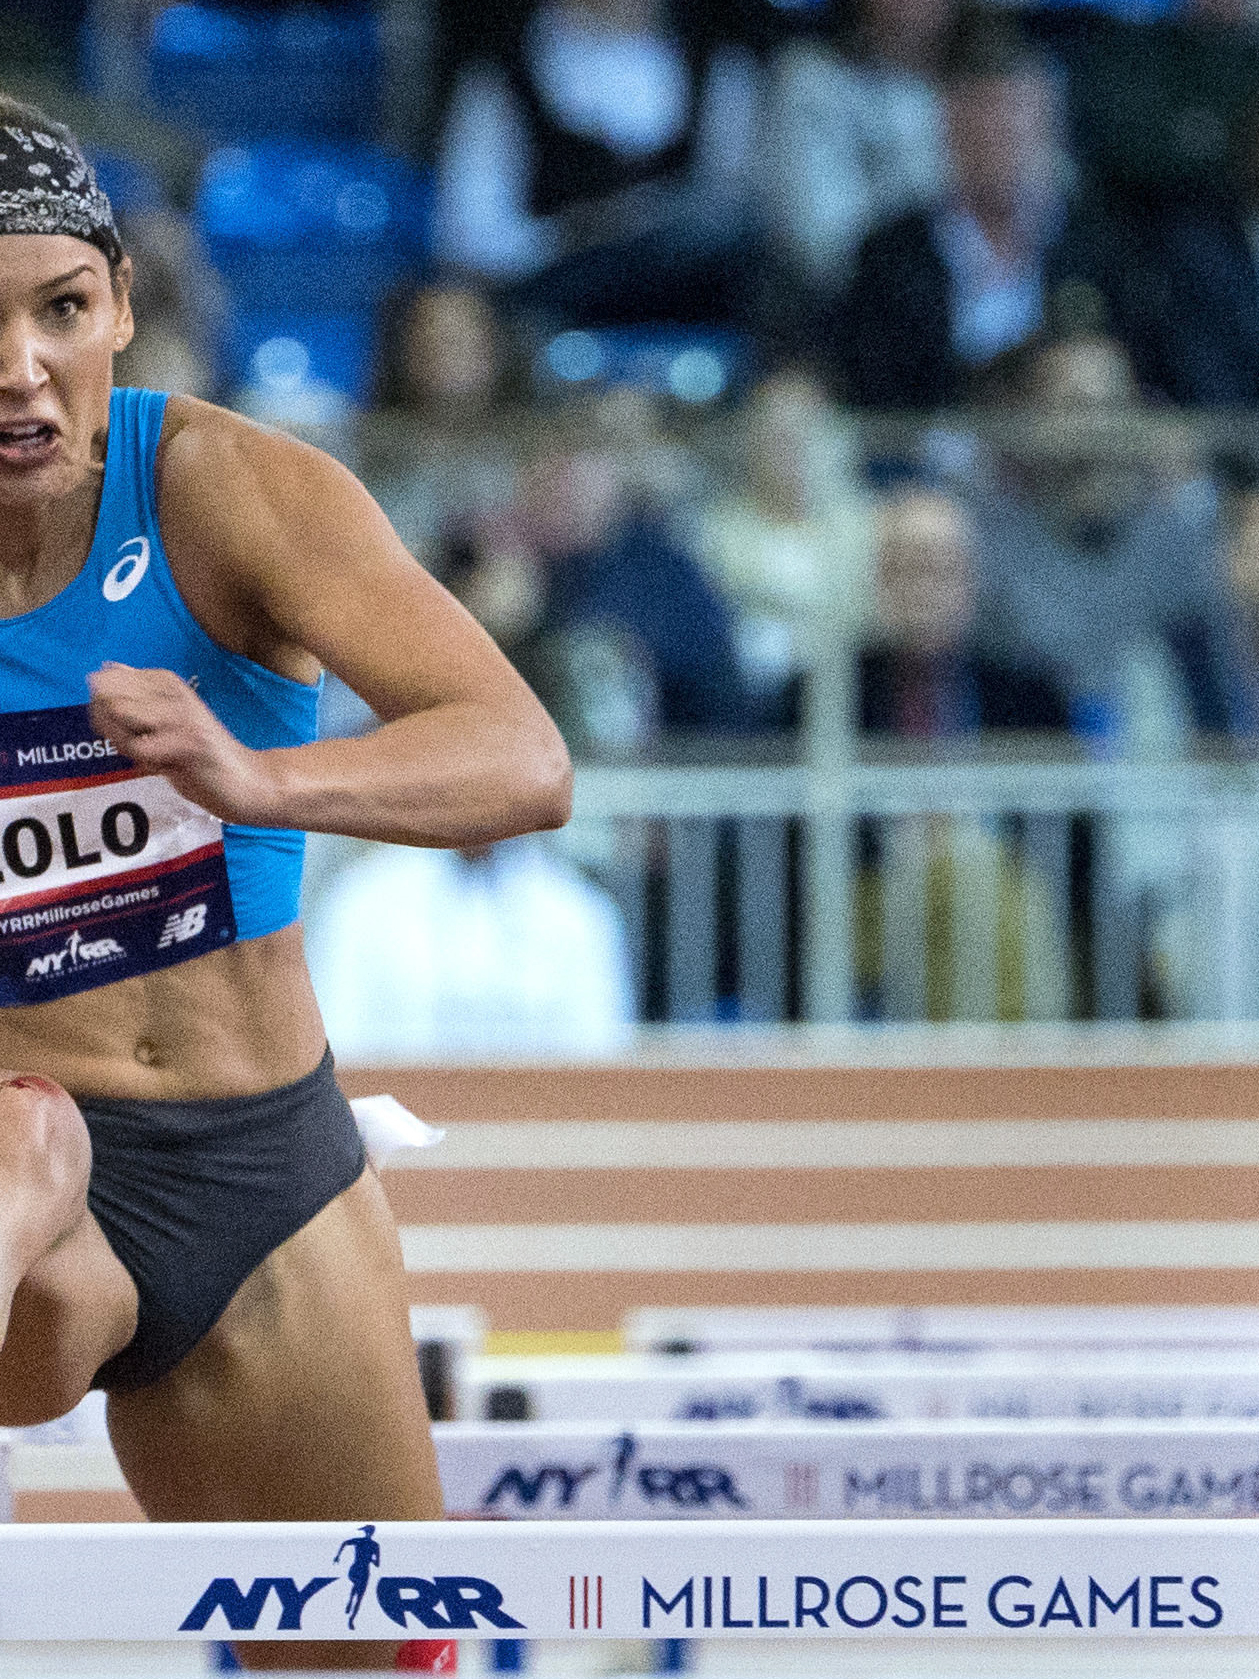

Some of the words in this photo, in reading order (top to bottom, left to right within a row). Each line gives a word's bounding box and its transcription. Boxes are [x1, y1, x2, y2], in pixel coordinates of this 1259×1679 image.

[17, 739, 118, 767] MILLROSE
[843, 1462, 1109, 1513] MILLROSE
[642, 1575, 967, 1629] MILLROSE
[987, 1574, 1223, 1629] GAMES
